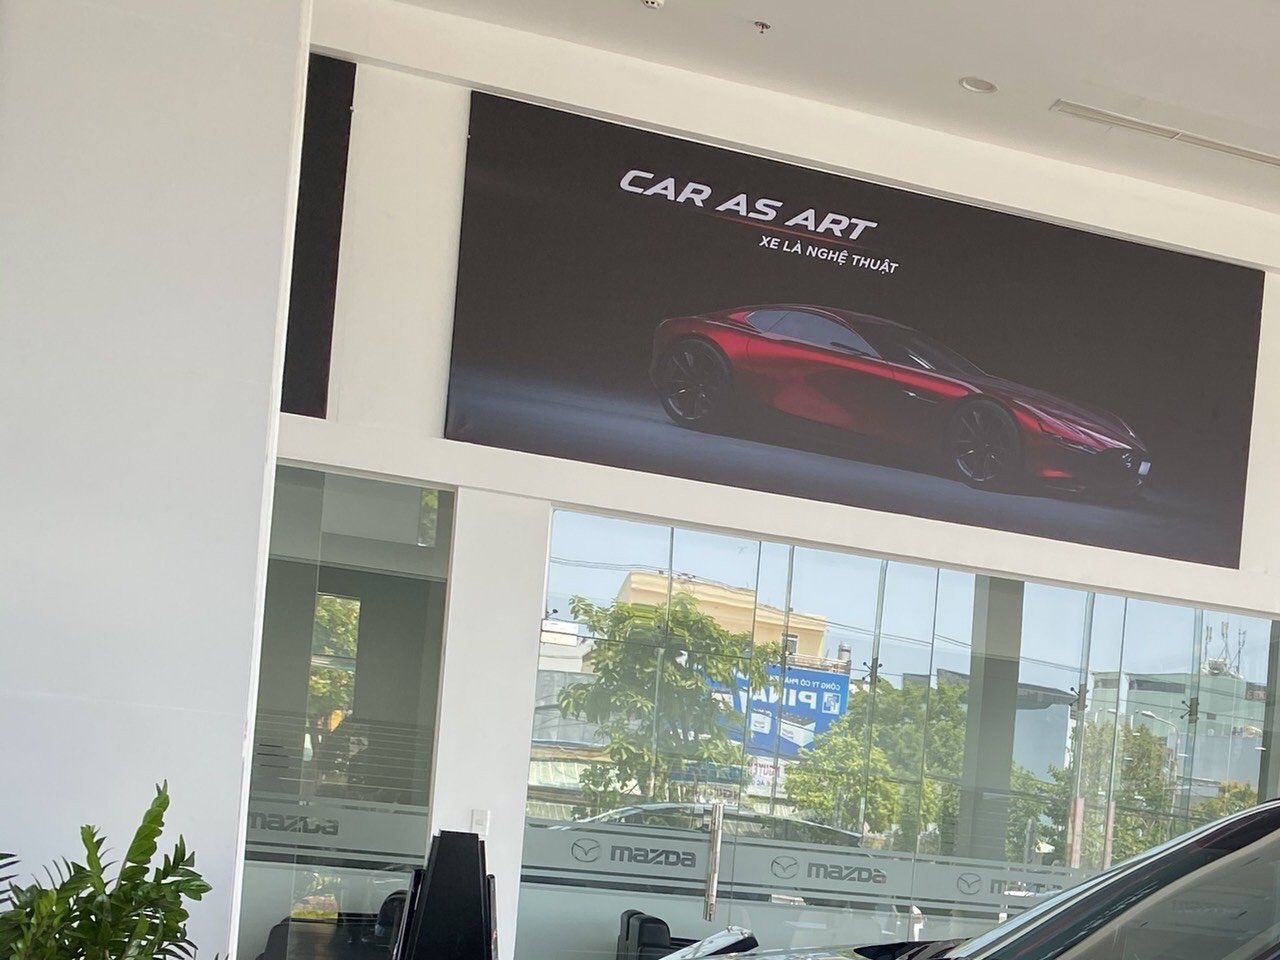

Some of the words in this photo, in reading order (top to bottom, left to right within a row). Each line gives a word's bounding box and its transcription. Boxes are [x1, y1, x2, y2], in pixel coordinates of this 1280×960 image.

[620, 169, 712, 207] CAR
[715, 194, 783, 221] AS
[784, 208, 878, 240] ART
[759, 235, 781, 250] XE
[783, 240, 802, 254] LÀ
[806, 245, 849, 265] NGHỆ
[852, 255, 899, 275] THUẬT
[610, 845, 697, 868] mazda
[807, 863, 887, 884] mazda
